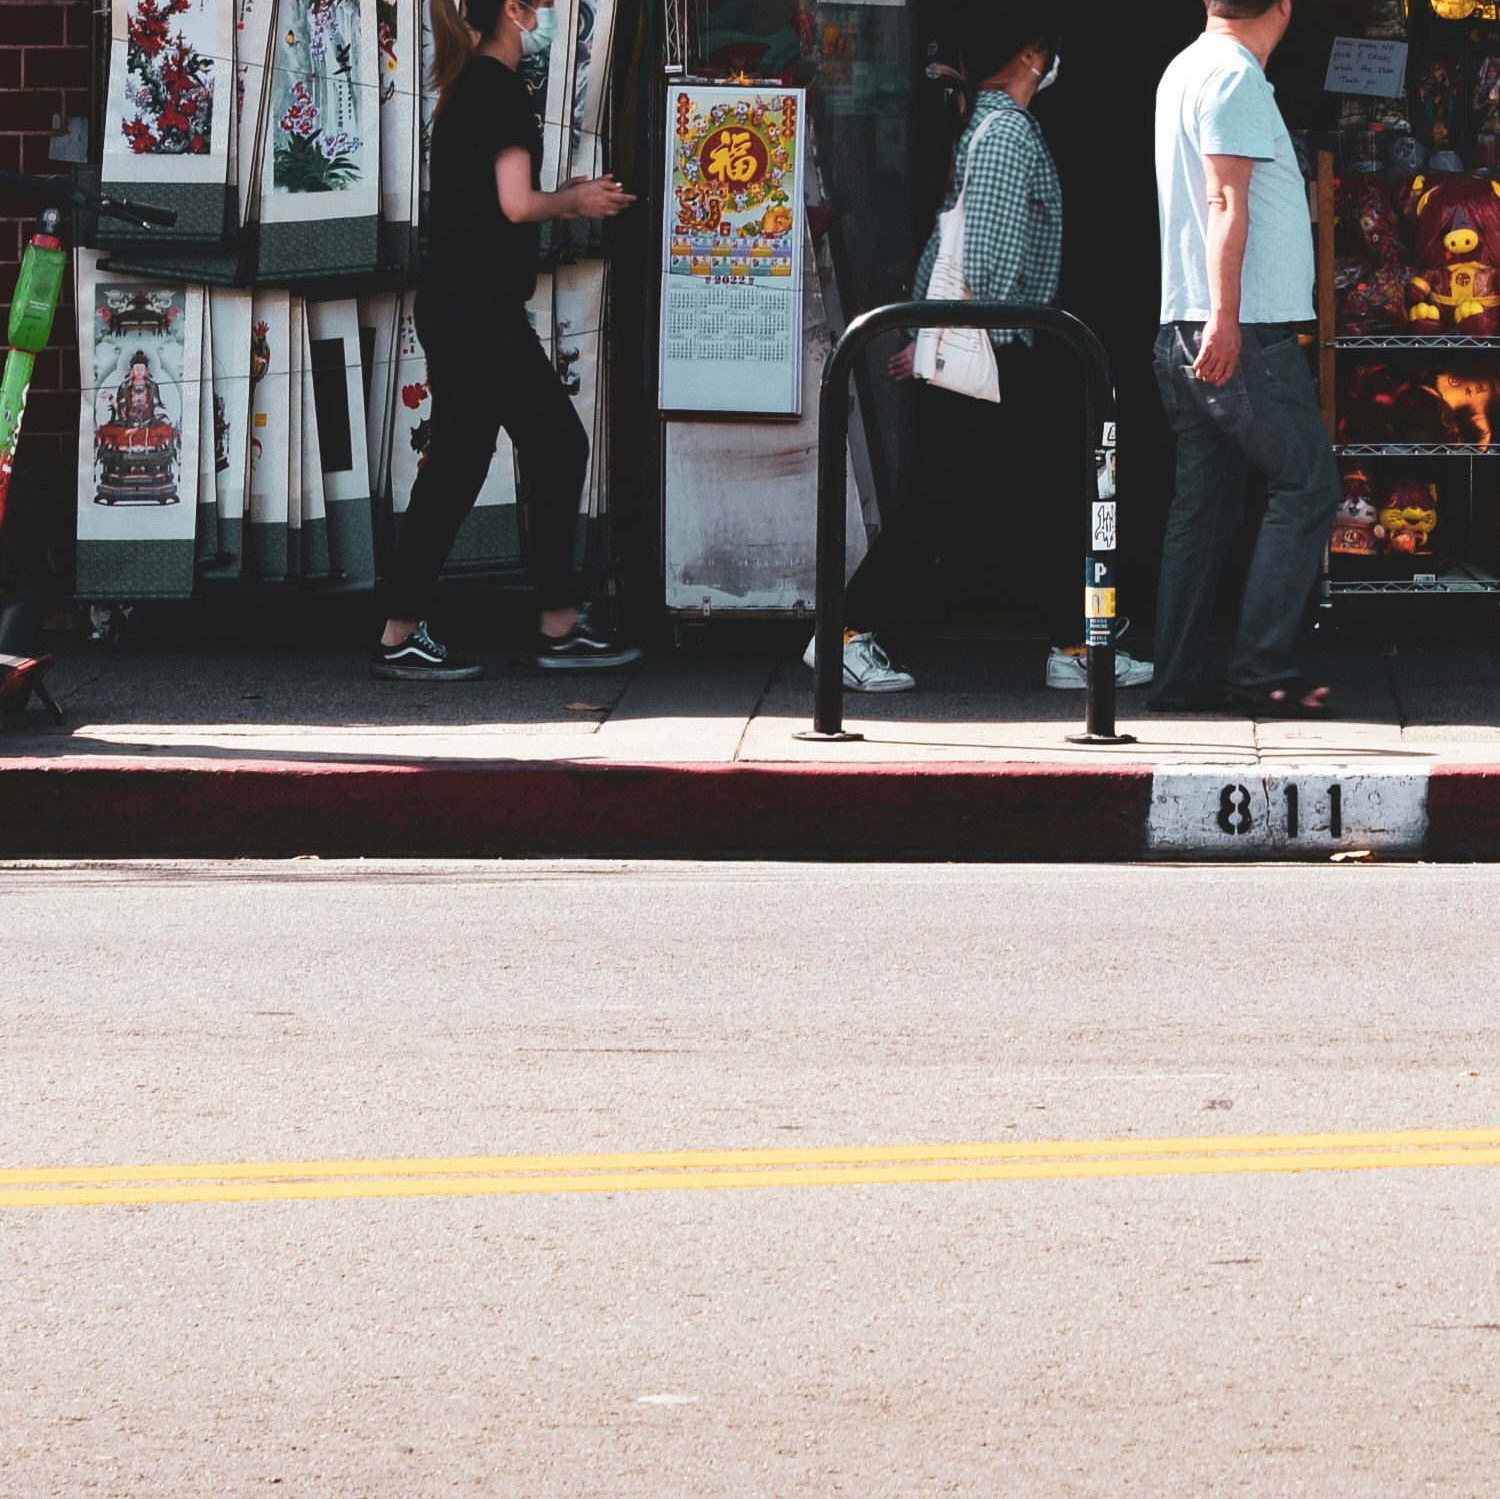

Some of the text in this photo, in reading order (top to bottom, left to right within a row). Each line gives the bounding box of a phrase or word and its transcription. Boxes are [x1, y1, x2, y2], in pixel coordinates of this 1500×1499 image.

[708, 131, 757, 184] 福
[714, 276, 745, 284] 2022
[1095, 563, 1107, 583] P
[1217, 783, 1341, 838] 811
